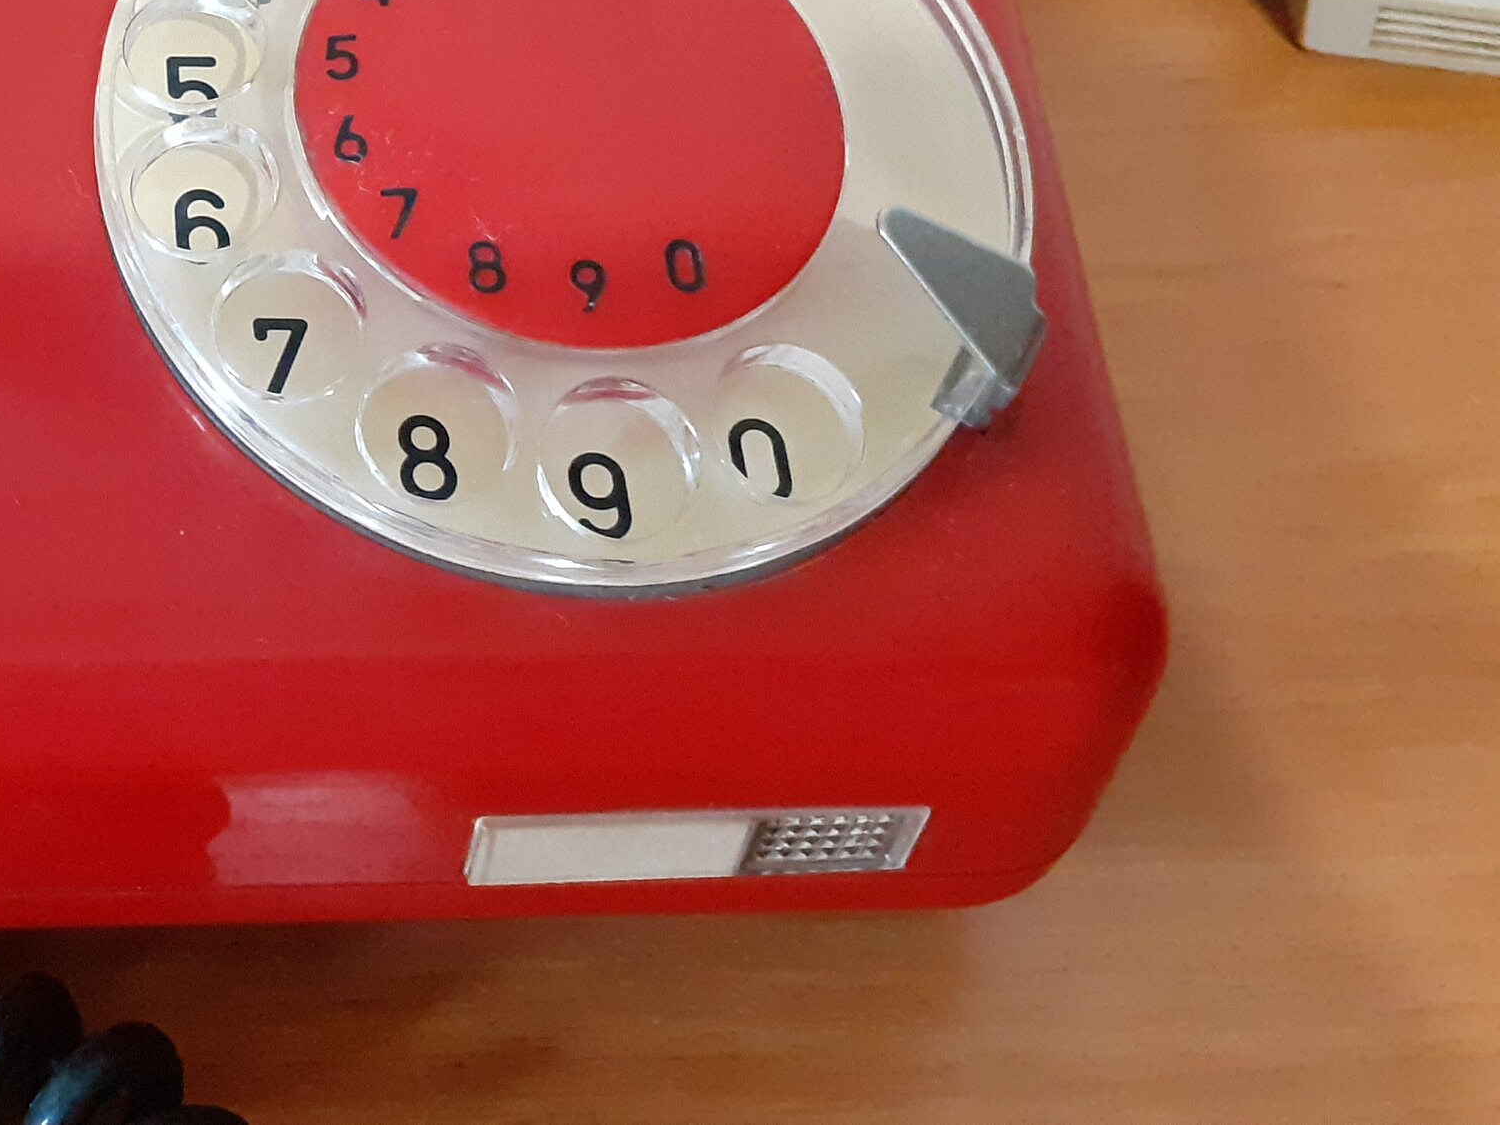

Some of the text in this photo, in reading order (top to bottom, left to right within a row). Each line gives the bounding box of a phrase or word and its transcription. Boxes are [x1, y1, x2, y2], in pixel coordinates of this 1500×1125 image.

[165, 56, 220, 102] 5
[325, 34, 360, 81] 5
[334, 114, 369, 164] 6
[173, 188, 232, 251] 6
[380, 187, 418, 239] 7
[468, 240, 508, 295] 8
[570, 259, 607, 314] 9
[664, 238, 707, 295] 0
[252, 317, 309, 396] 7
[397, 414, 459, 501] 8
[566, 451, 634, 540] 9
